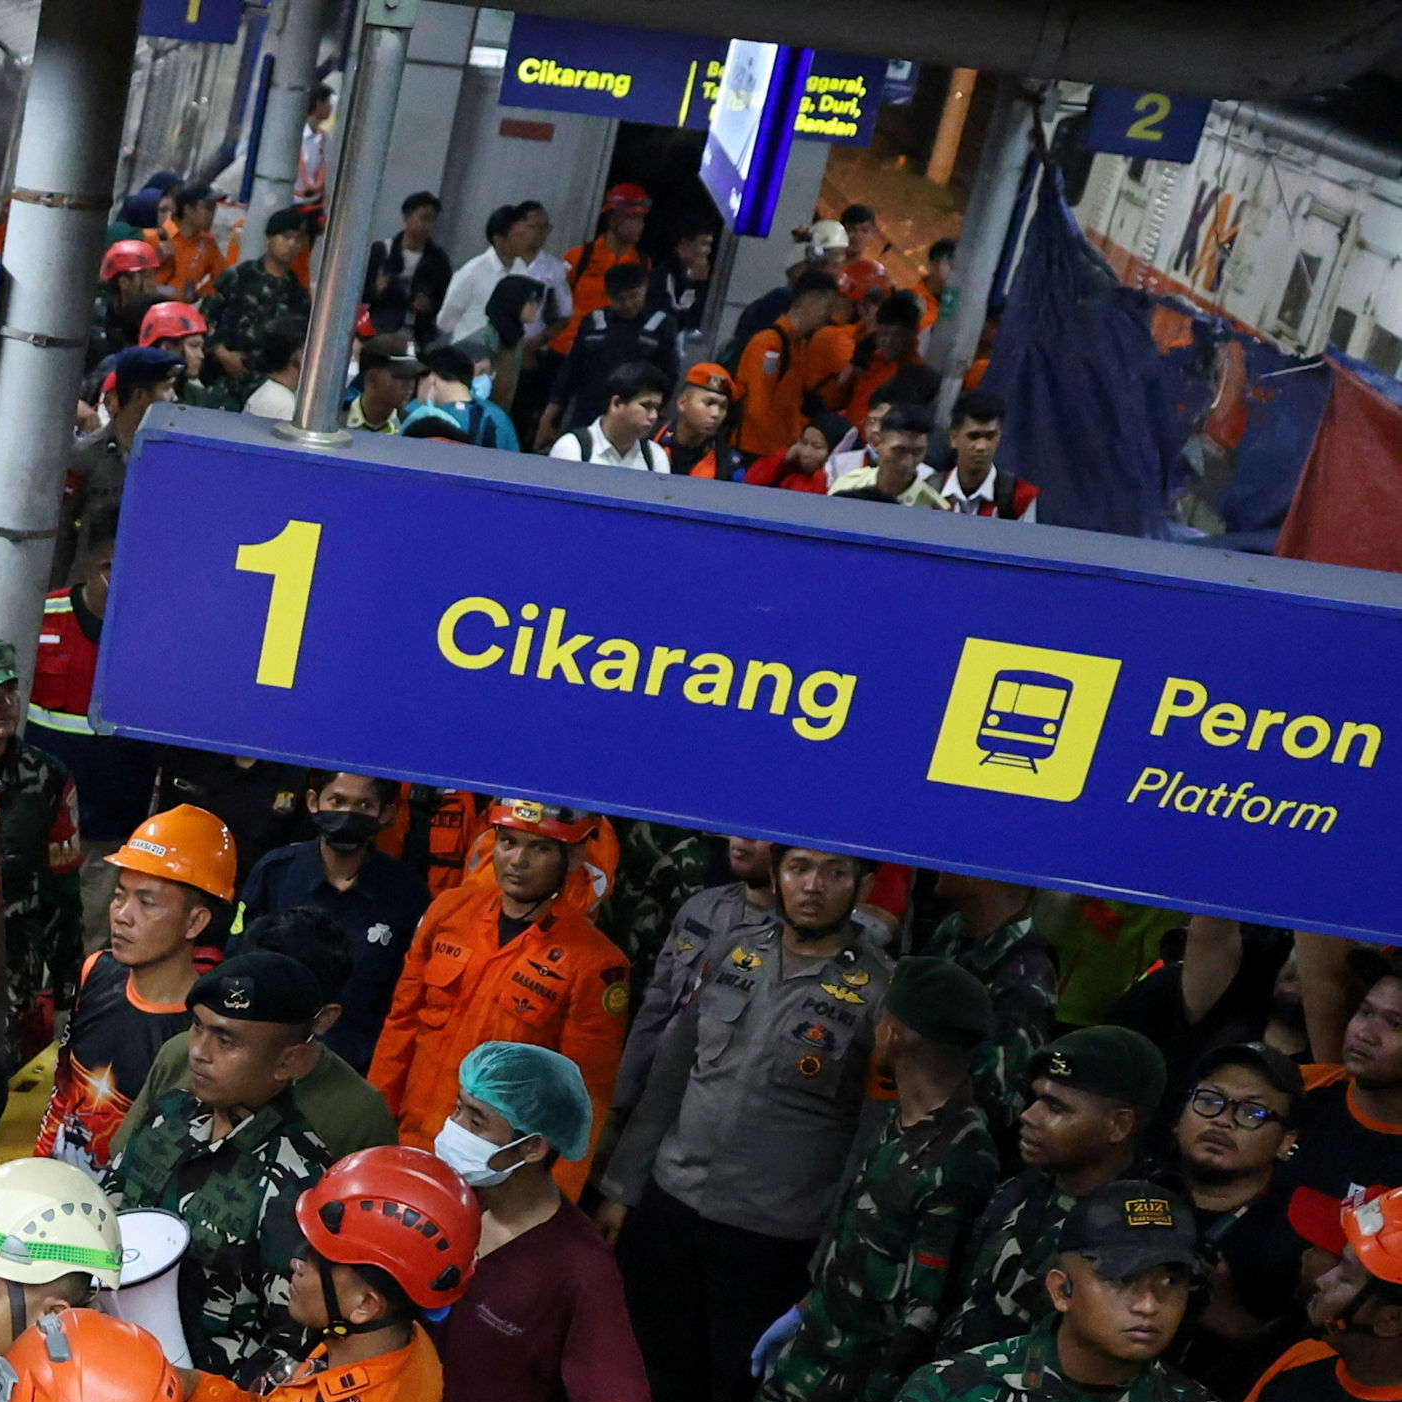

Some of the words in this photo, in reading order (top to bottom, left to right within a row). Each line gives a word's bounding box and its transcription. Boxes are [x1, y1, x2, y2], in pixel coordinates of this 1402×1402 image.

[516, 57, 632, 98] Cikarang
[1127, 93, 1171, 141] 2
[235, 519, 322, 690] 1
[436, 595, 858, 742] Cikarang
[1150, 676, 1383, 769] Peron
[1126, 765, 1340, 832] Platform
[1133, 1202, 1164, 1213] 202
